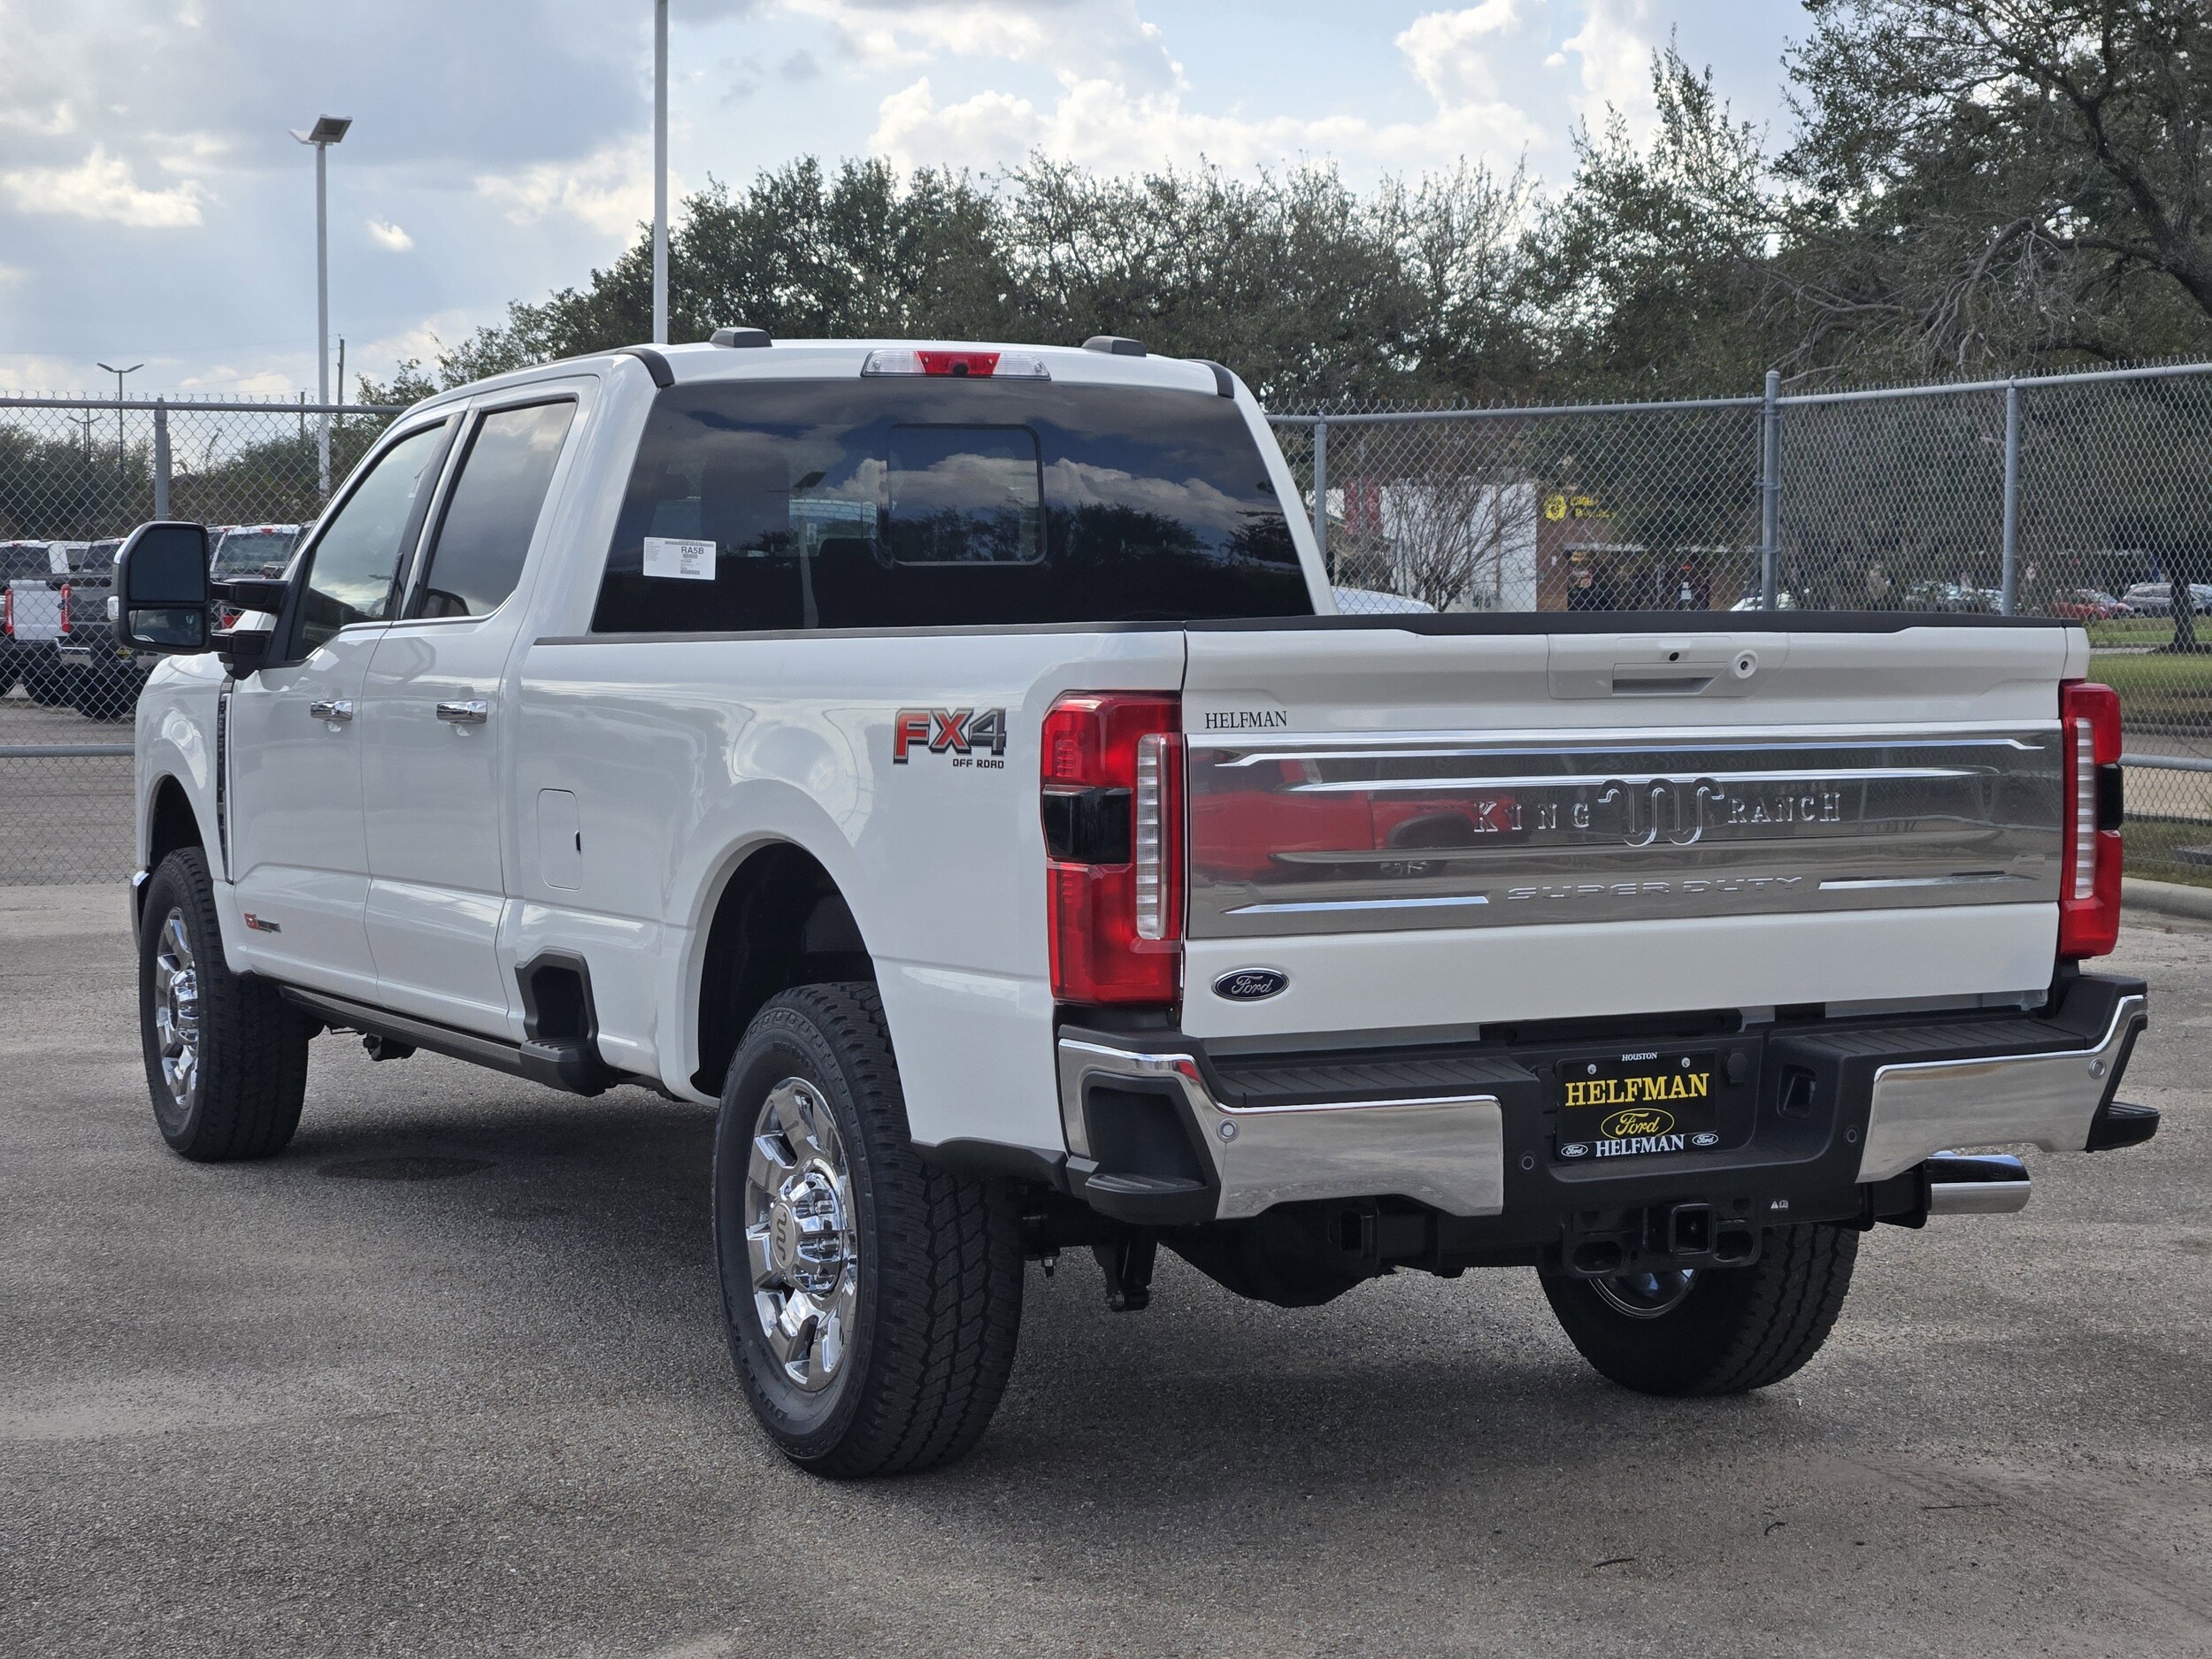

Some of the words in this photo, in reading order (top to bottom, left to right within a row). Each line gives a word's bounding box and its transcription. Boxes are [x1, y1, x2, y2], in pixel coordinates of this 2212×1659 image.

[681, 546, 704, 555] RA5B
[1205, 710, 1286, 729] HELFMAN
[893, 708, 1006, 764] FX4
[952, 758, 973, 768] OFF
[977, 759, 1004, 770] ROAD
[1473, 799, 1590, 833] KING
[1727, 792, 1841, 824] RANCH
[1508, 880, 1671, 901] SUPER
[1683, 876, 1803, 895] DUTY
[1231, 975, 1273, 995] Ford
[1622, 1052, 1657, 1062] HOUSTON
[1565, 1073, 1709, 1106] HELFMAN
[1615, 1112, 1660, 1136] Ford
[1595, 1134, 1686, 1157] HELFMAN
